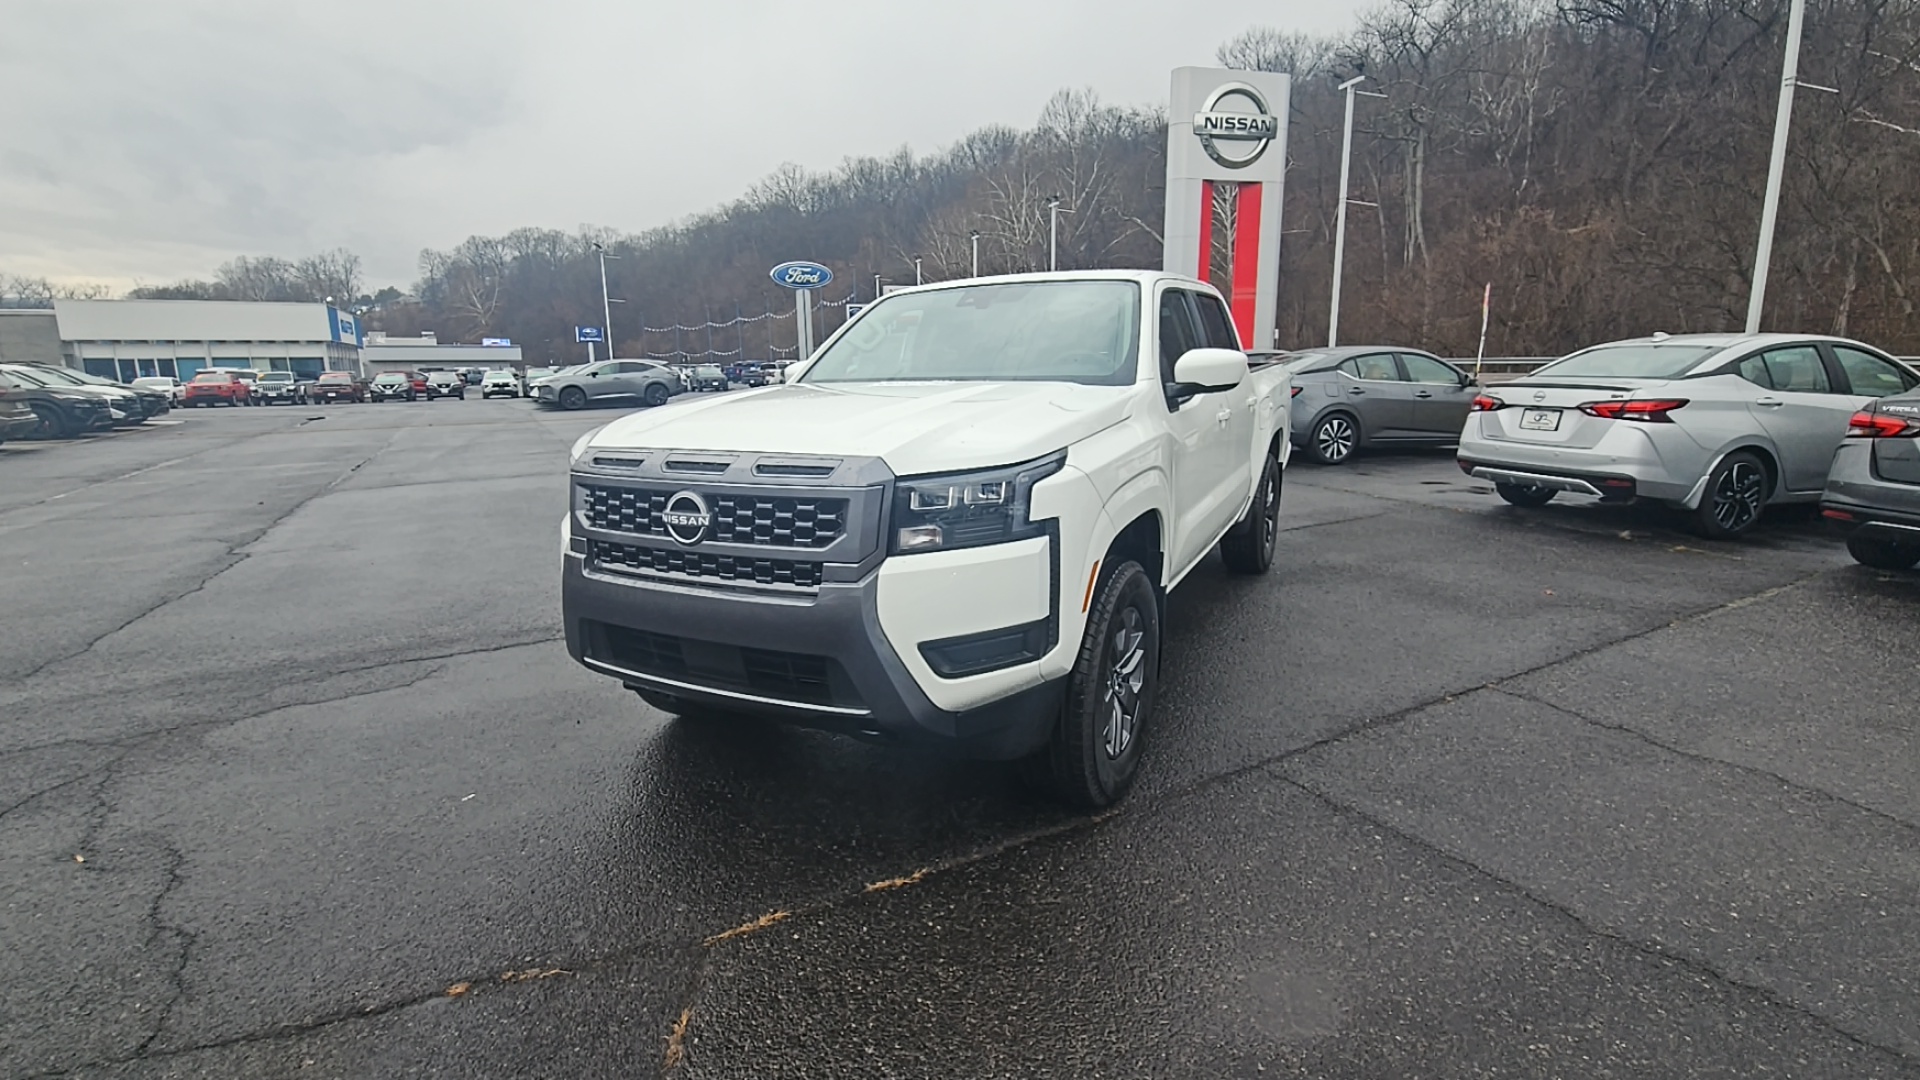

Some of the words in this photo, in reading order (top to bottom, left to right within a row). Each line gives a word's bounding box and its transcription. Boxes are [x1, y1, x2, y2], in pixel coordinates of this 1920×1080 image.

[1203, 116, 1271, 133] NISSAN
[785, 266, 820, 283] Ford
[662, 513, 710, 526] NISSAN
